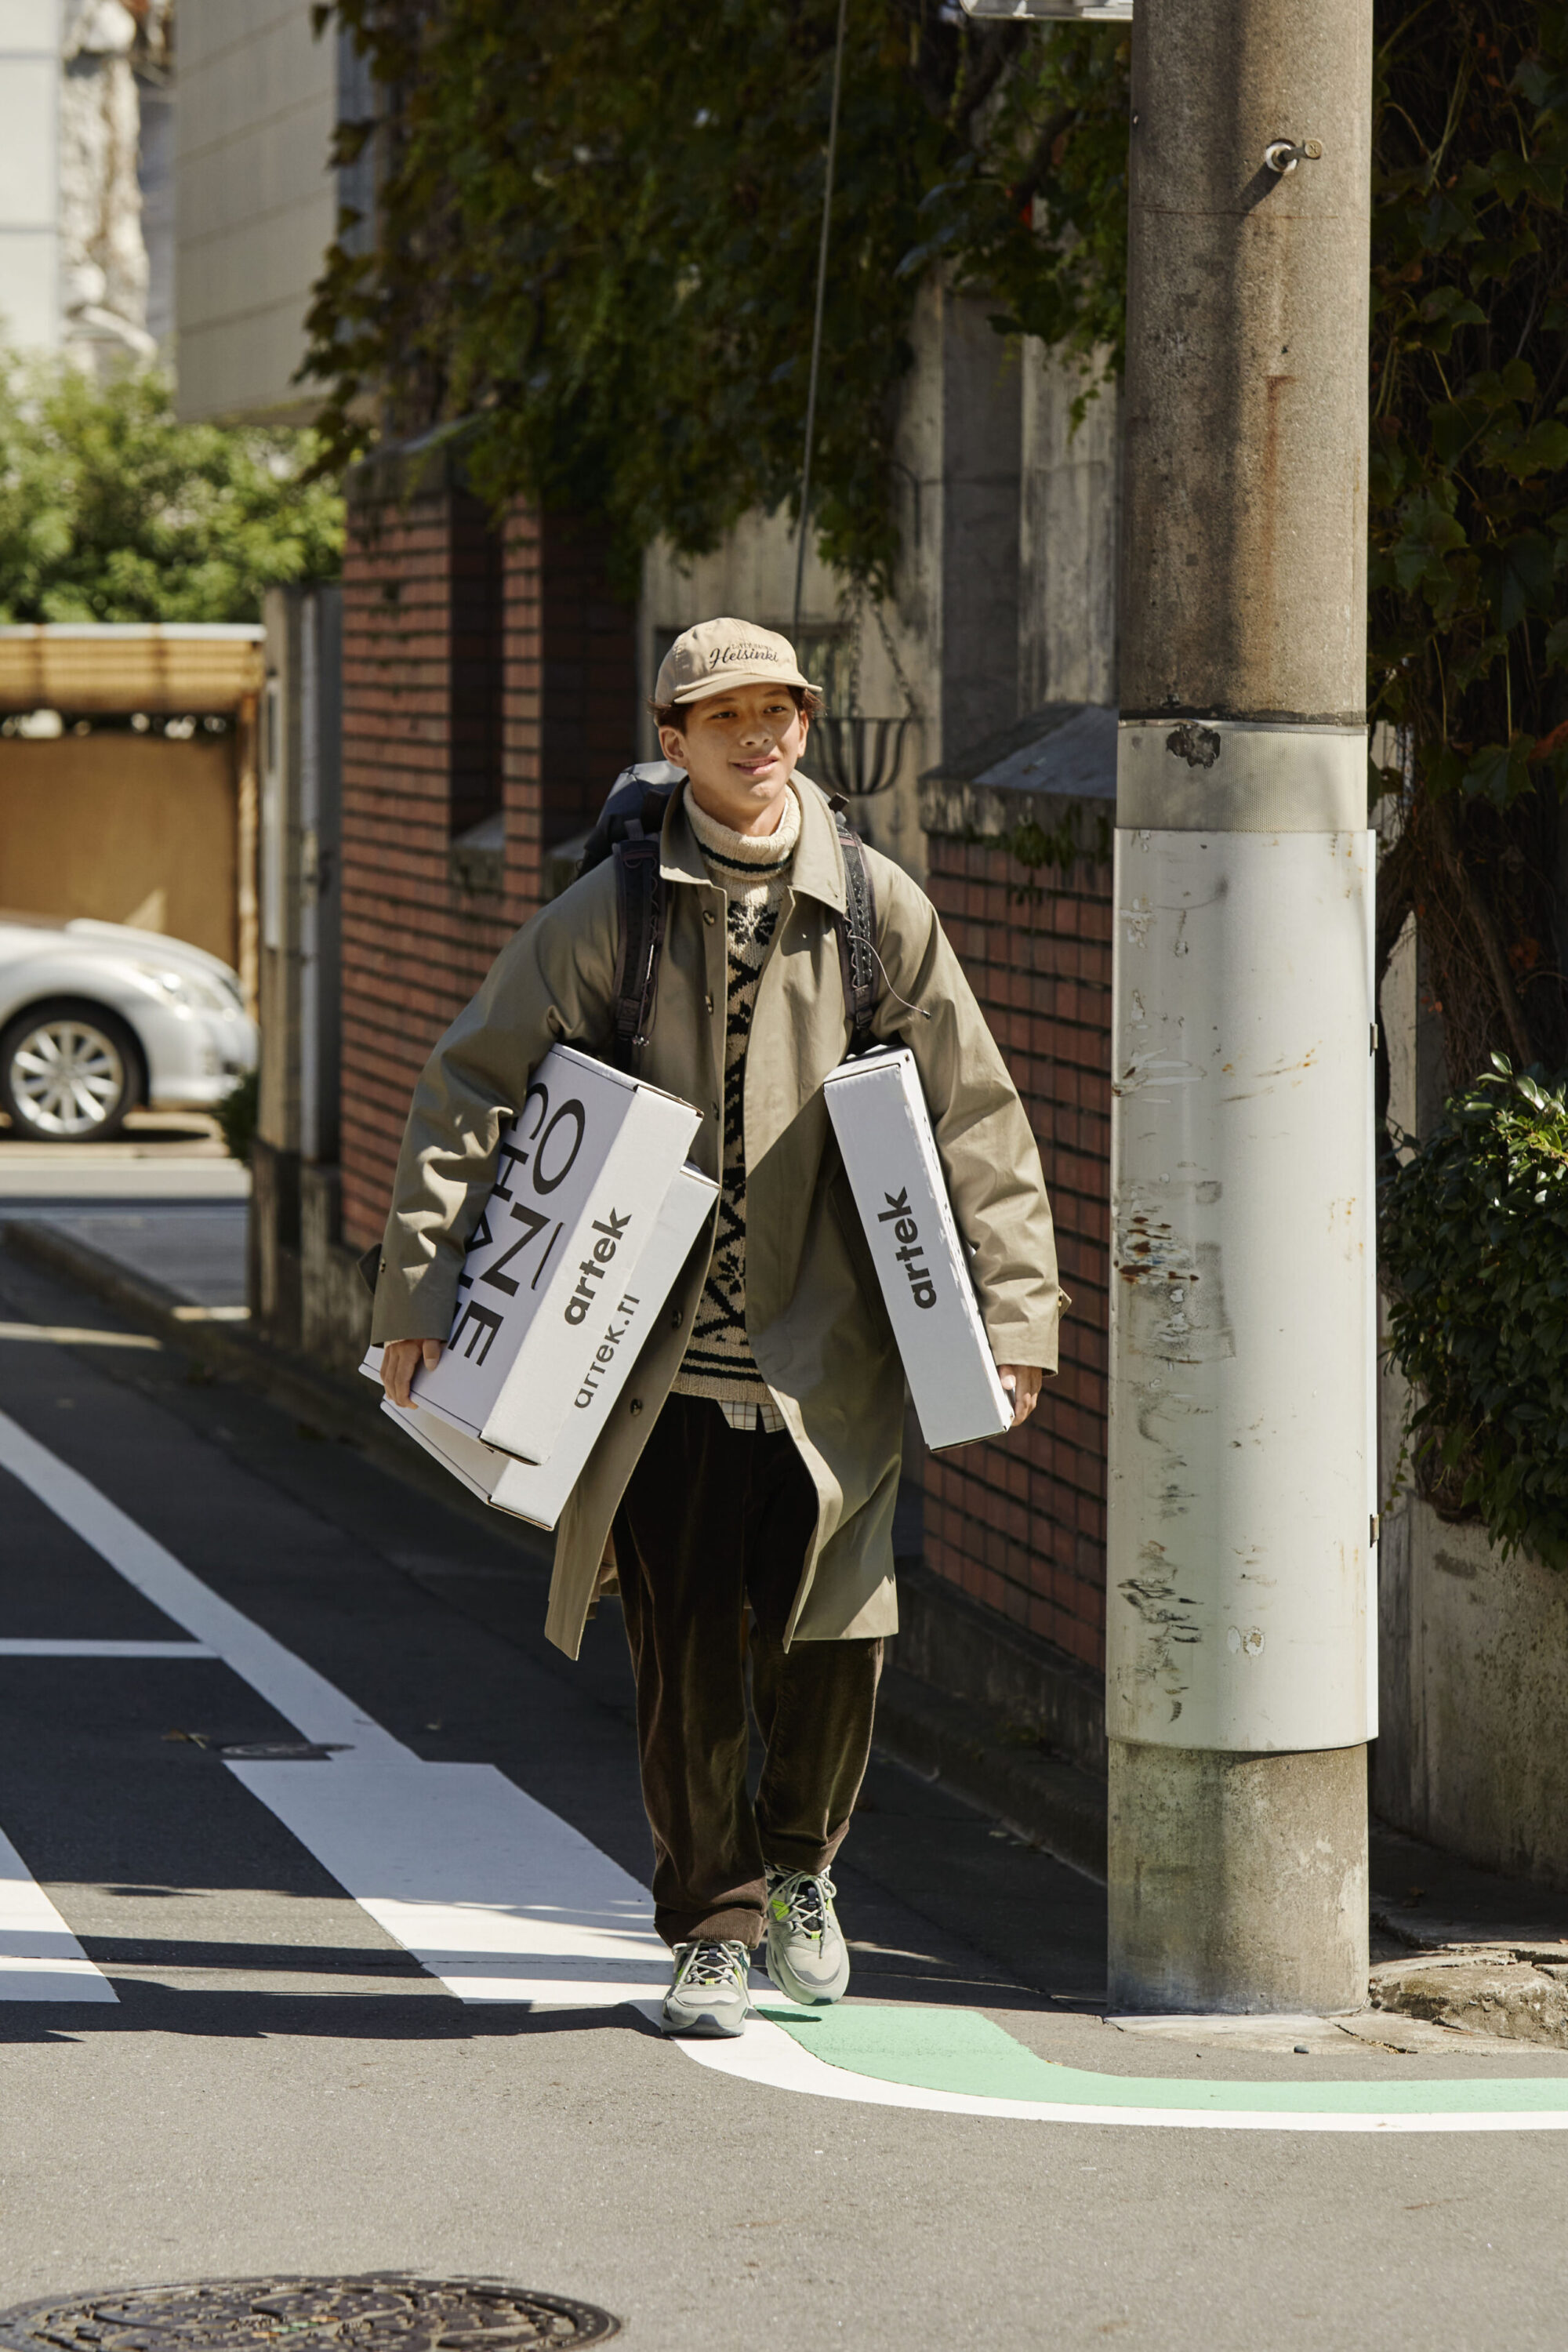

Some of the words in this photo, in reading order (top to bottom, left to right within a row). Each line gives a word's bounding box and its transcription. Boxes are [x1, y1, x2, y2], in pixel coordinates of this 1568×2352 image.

[710, 648, 779, 669] Helsinki
[448, 1098, 586, 1367] ONE
[452, 1083, 549, 1327] CHA
[564, 1207, 632, 1326] artek
[877, 1186, 937, 1309] artek
